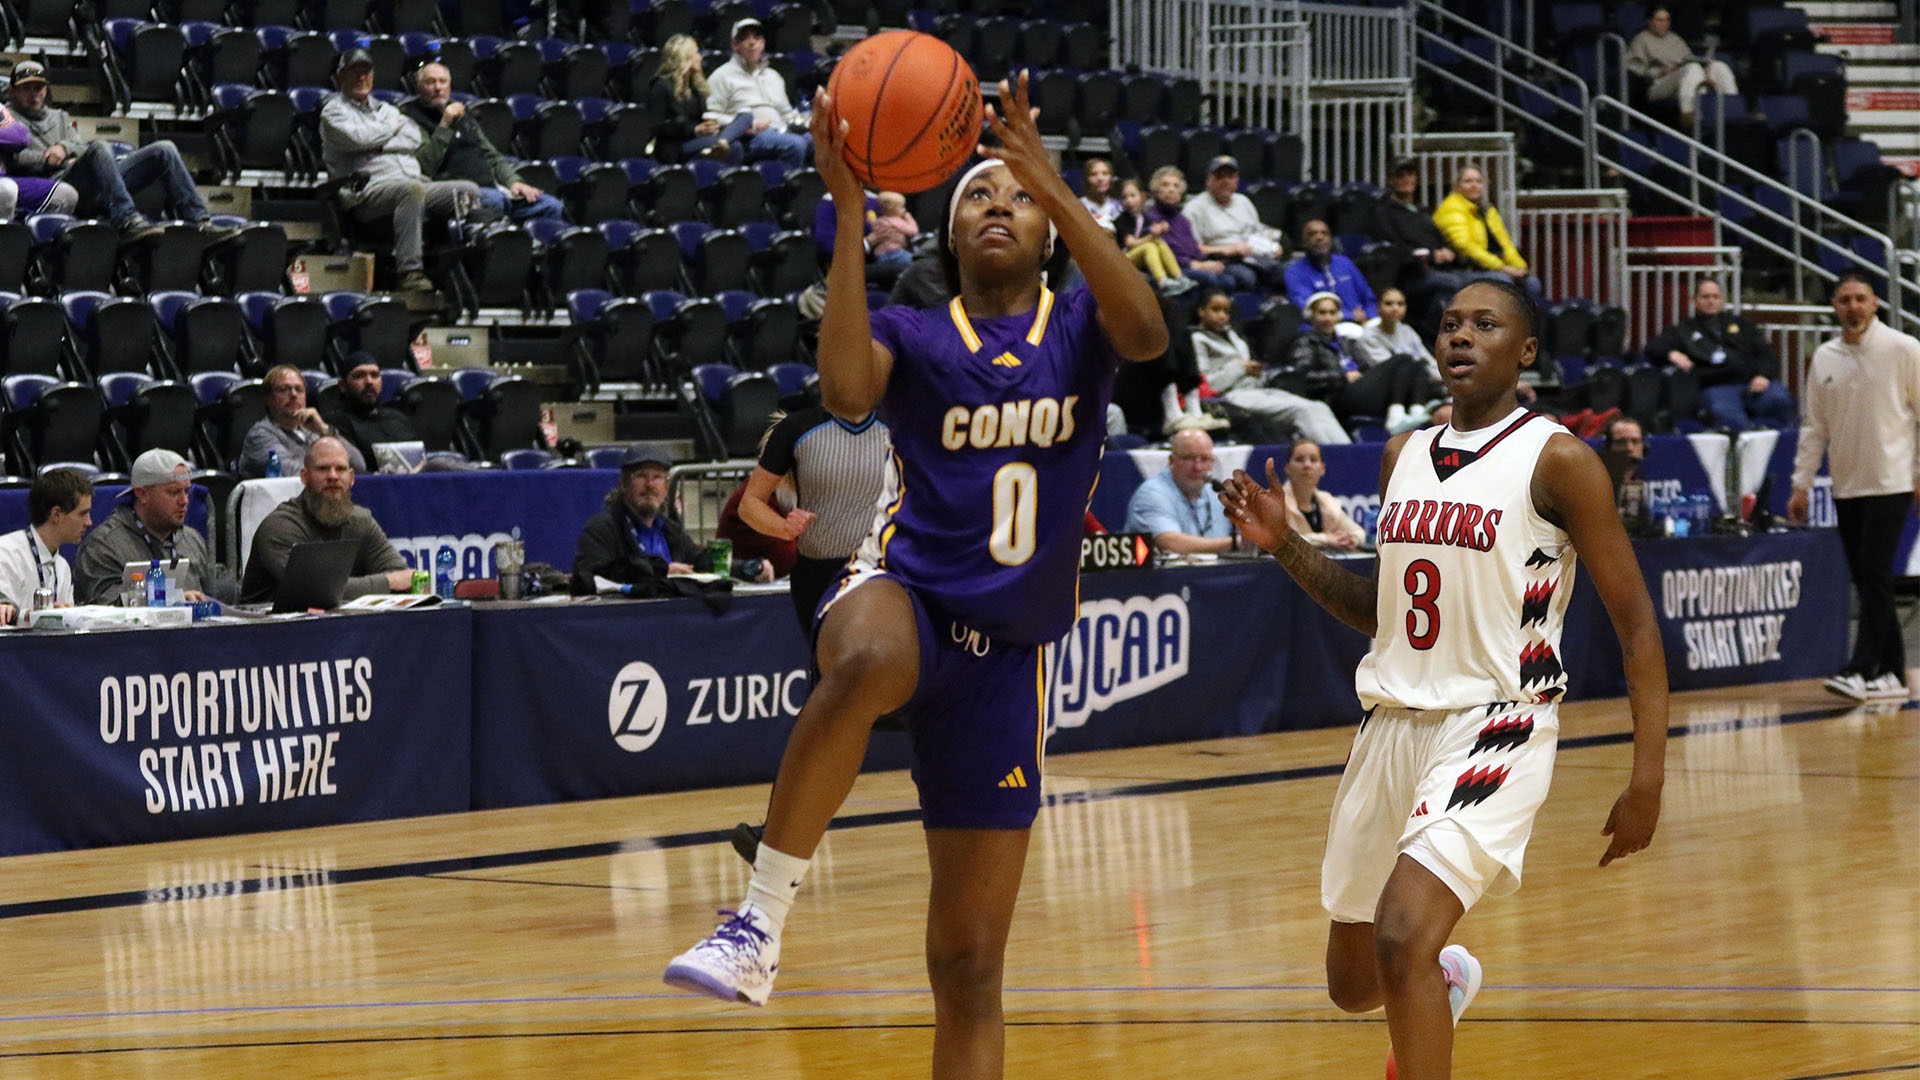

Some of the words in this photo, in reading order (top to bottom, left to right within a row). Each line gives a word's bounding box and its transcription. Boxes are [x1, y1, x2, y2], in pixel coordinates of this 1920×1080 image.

[942, 396, 1079, 450] CONQS
[989, 462, 1038, 566] 0
[1080, 535, 1136, 568] POSS.
[1403, 558, 1441, 650] 3
[1662, 560, 1802, 619] OPPORTUNITIES
[1683, 618, 1740, 671] START
[100, 657, 373, 745] OPPORTUNITIES
[686, 669, 811, 726] ZURIC
[139, 741, 244, 815] START
[254, 731, 340, 803] HERE
